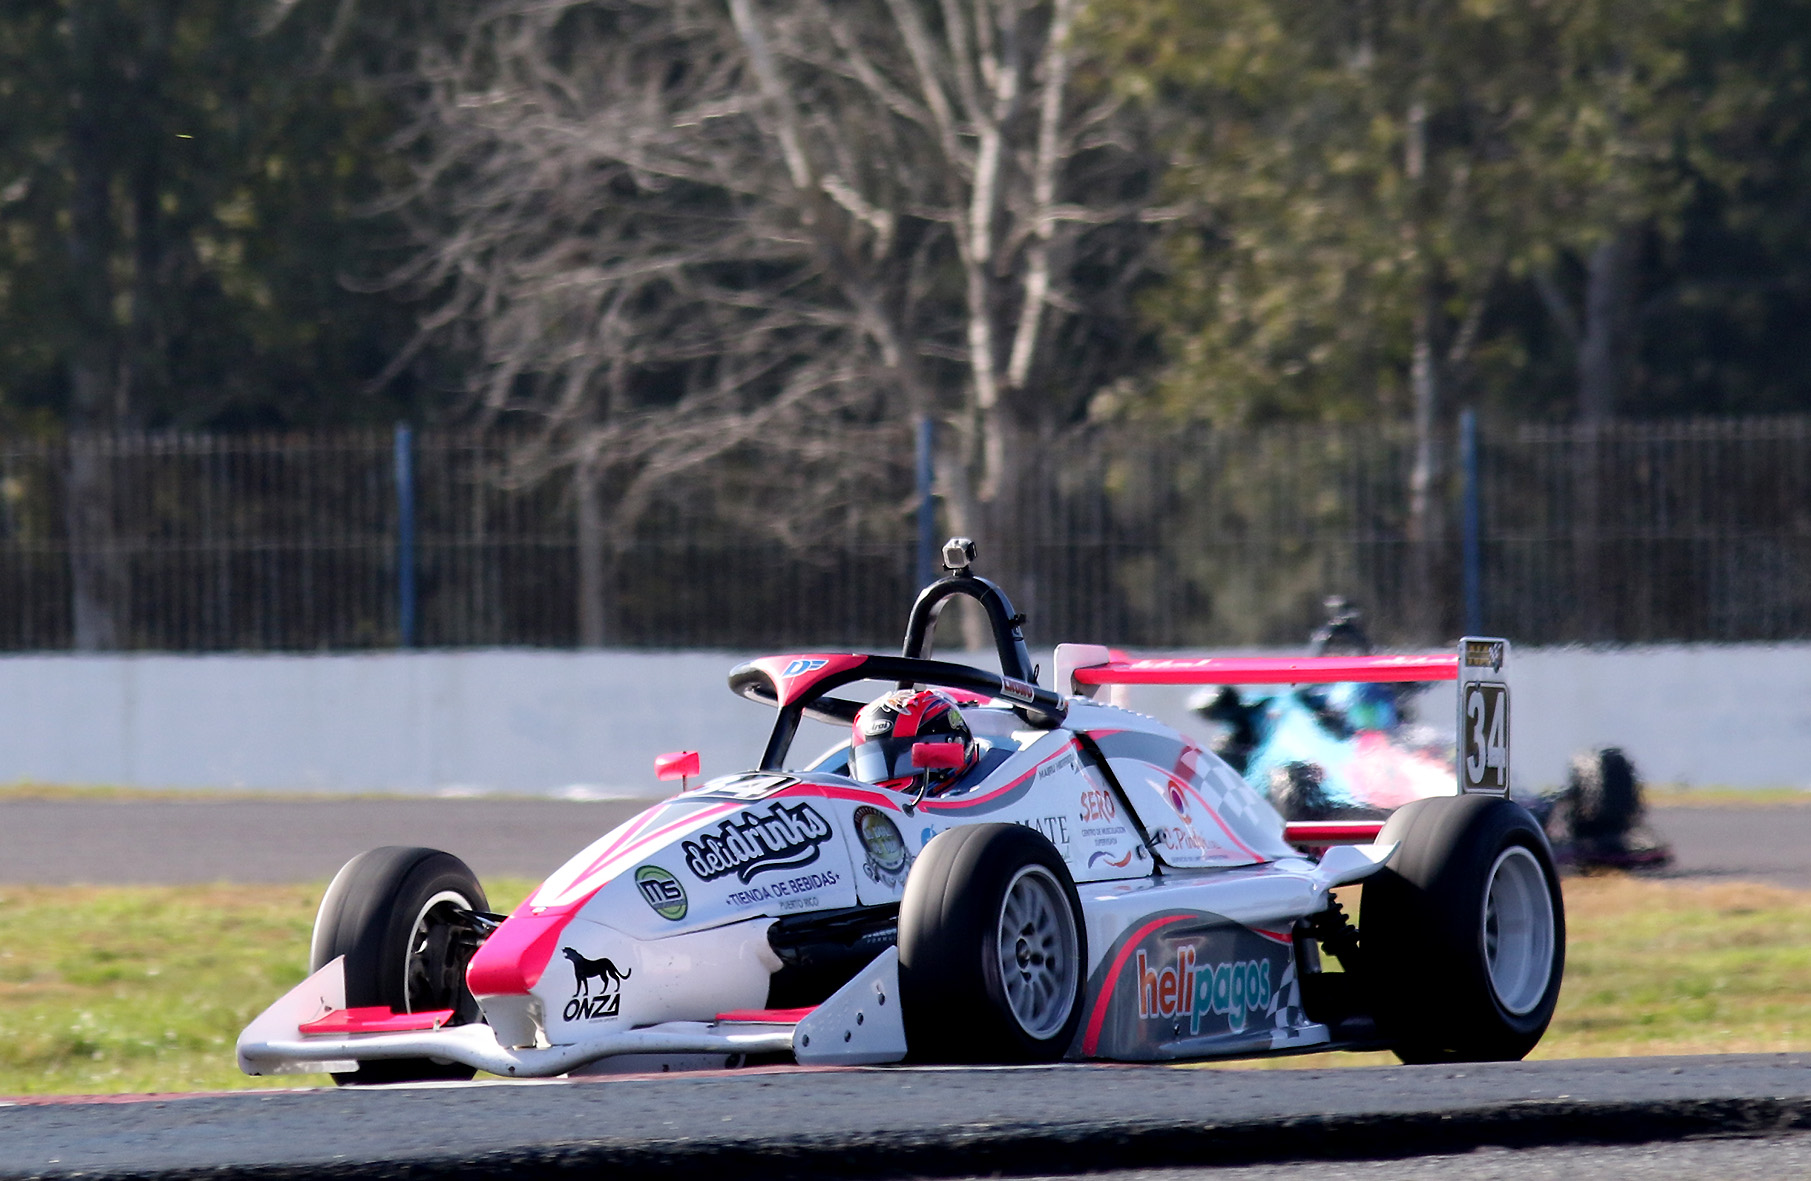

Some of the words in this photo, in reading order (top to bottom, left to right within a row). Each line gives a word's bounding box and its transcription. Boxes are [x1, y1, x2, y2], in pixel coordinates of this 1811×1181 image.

[1467, 691, 1506, 785] 34
[1080, 790, 1116, 823] SERO
[687, 804, 831, 880] delidrinks
[728, 886, 773, 906] TIENDA
[771, 882, 791, 897] DE
[789, 871, 837, 893] BEBIDAS
[563, 993, 620, 1022] ONZA
[1136, 944, 1271, 1035] helipagos
